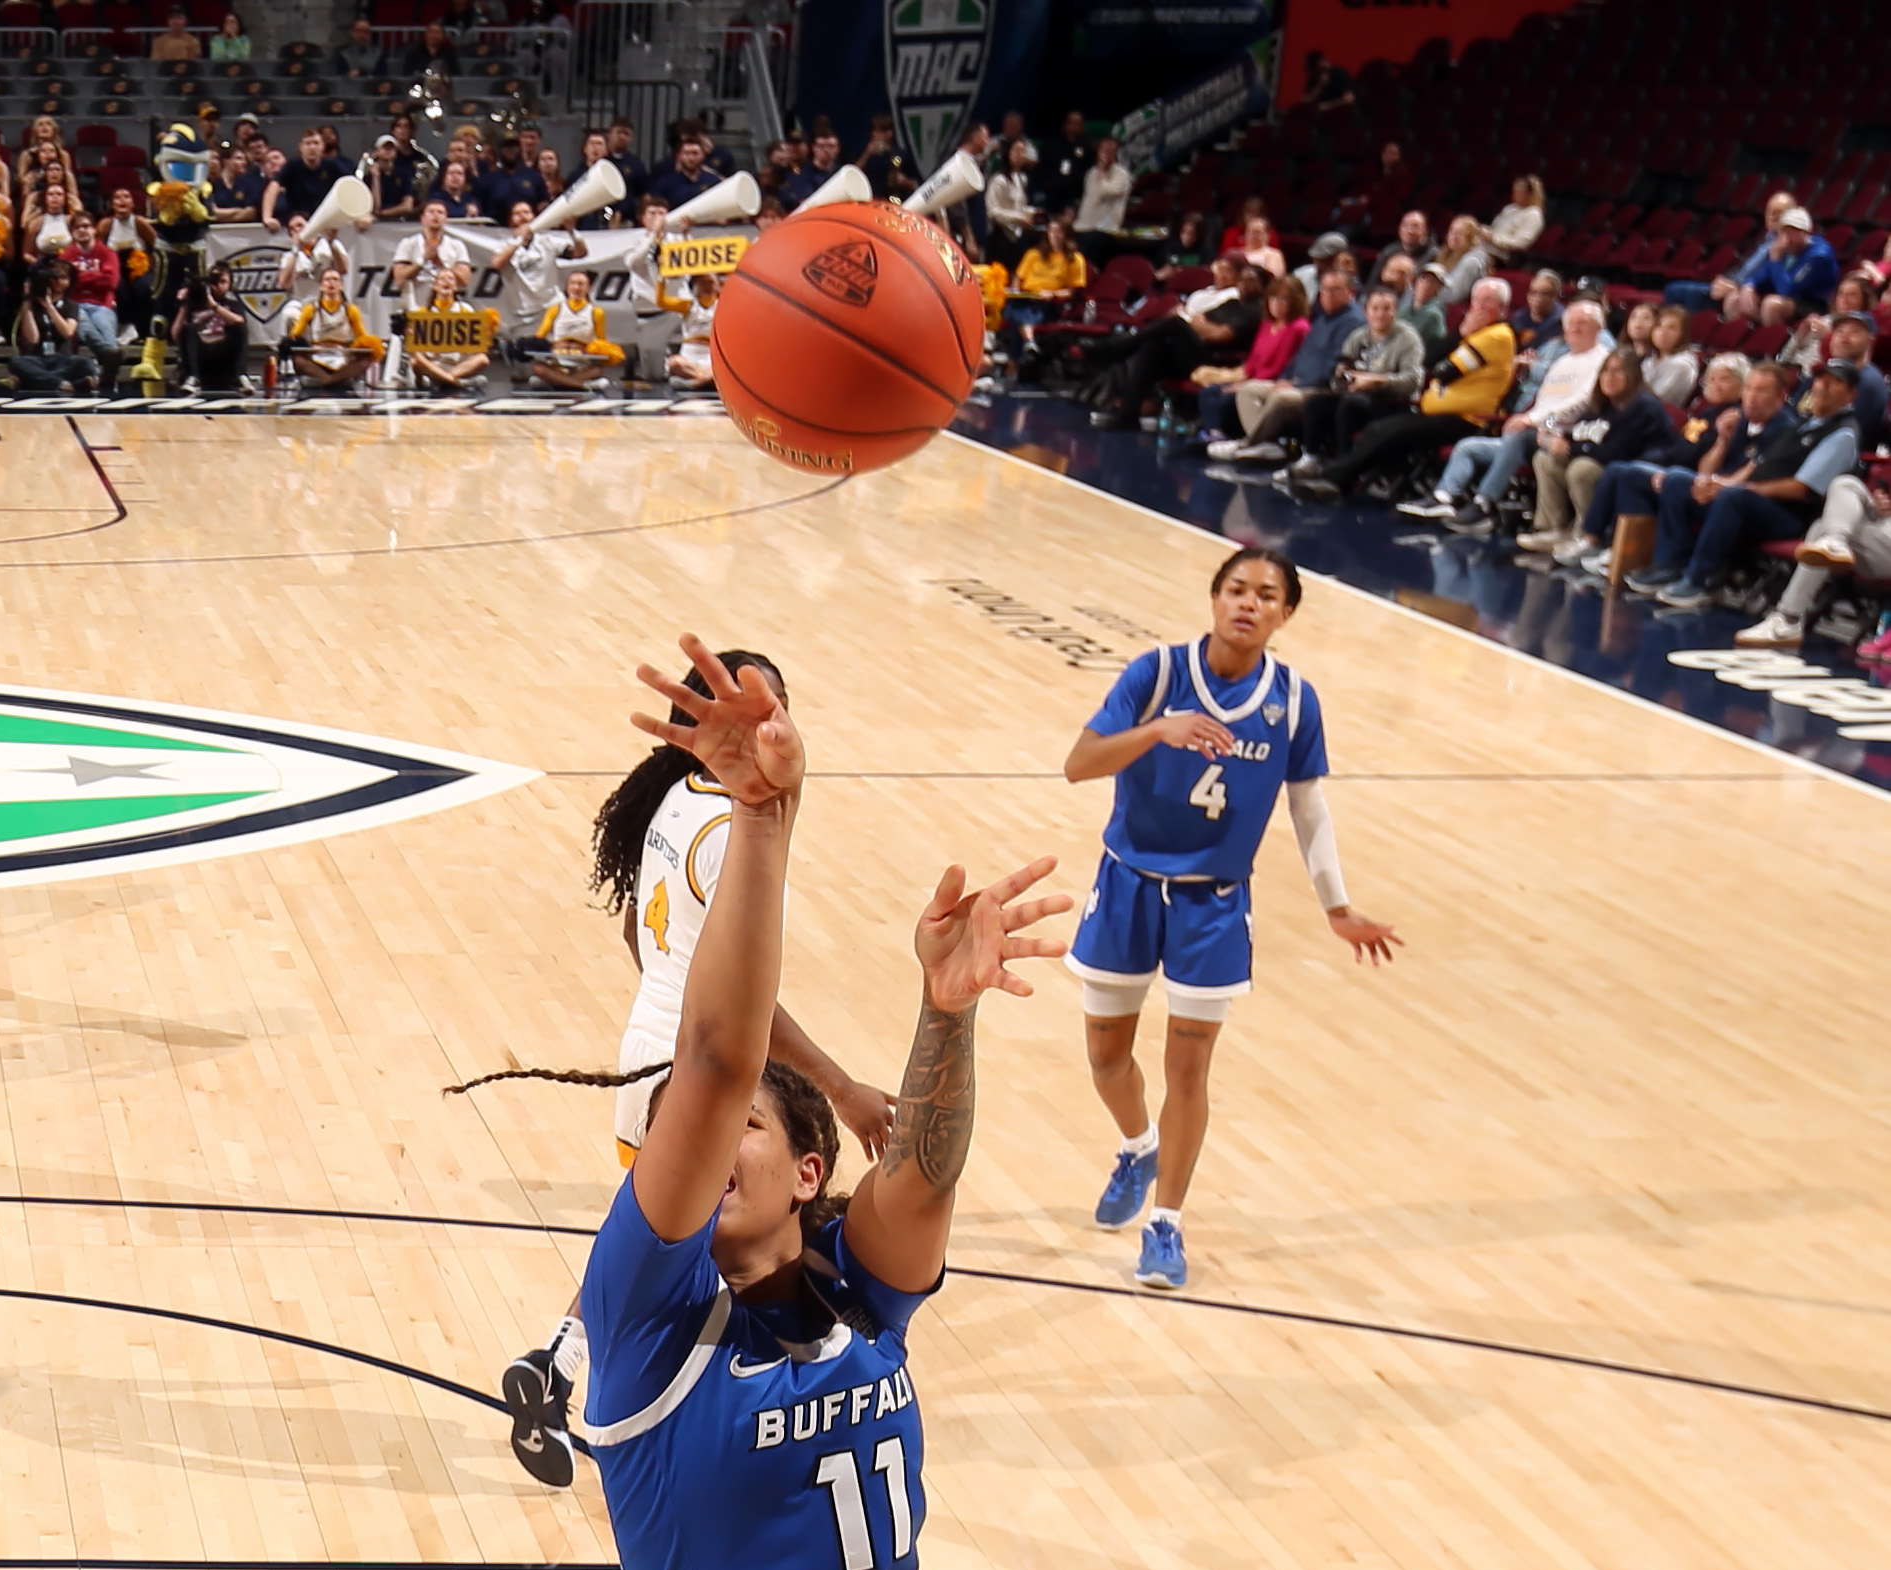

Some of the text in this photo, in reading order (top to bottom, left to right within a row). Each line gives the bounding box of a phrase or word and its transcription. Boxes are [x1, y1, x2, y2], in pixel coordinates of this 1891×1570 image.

[896, 40, 981, 97] MAC
[669, 244, 738, 269] NOISE
[231, 270, 283, 291] MA
[413, 319, 482, 346] NOISE
[1666, 649, 1891, 741] rena
[1189, 763, 1226, 821] 4
